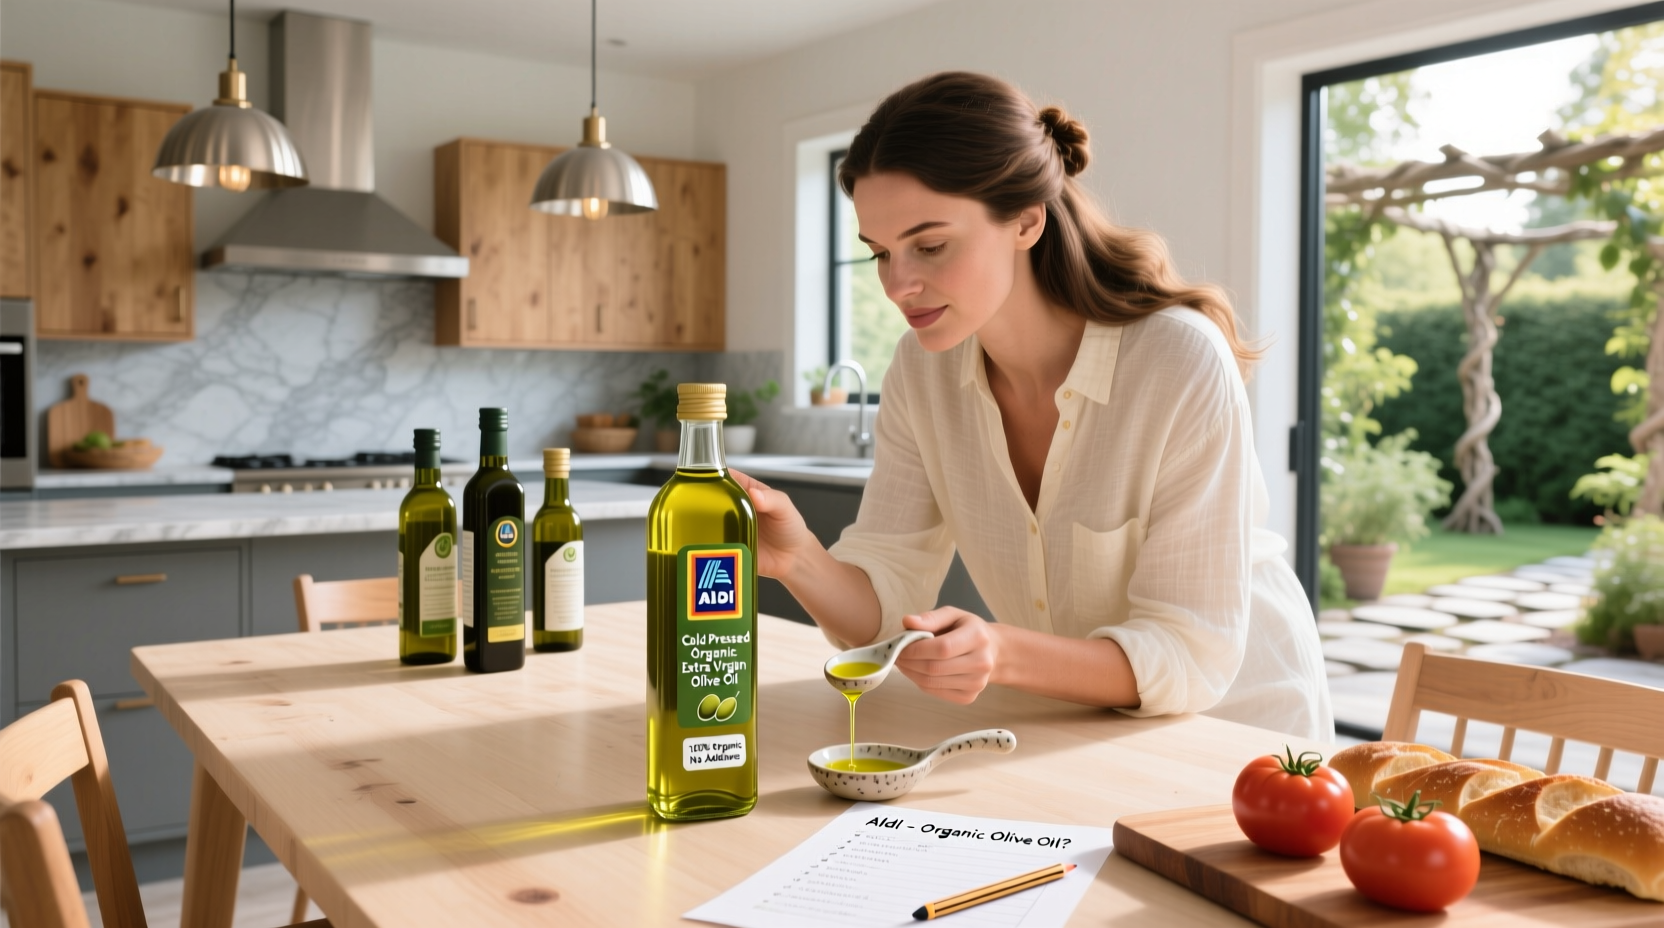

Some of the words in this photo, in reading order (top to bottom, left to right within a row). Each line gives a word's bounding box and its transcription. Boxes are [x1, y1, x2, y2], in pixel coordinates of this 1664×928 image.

[681, 632, 706, 646] Cold
[690, 646, 738, 662] Organic
[920, 823, 985, 839] Organic
[990, 831, 1033, 845] Olive
[1037, 836, 1072, 850] Oil?
